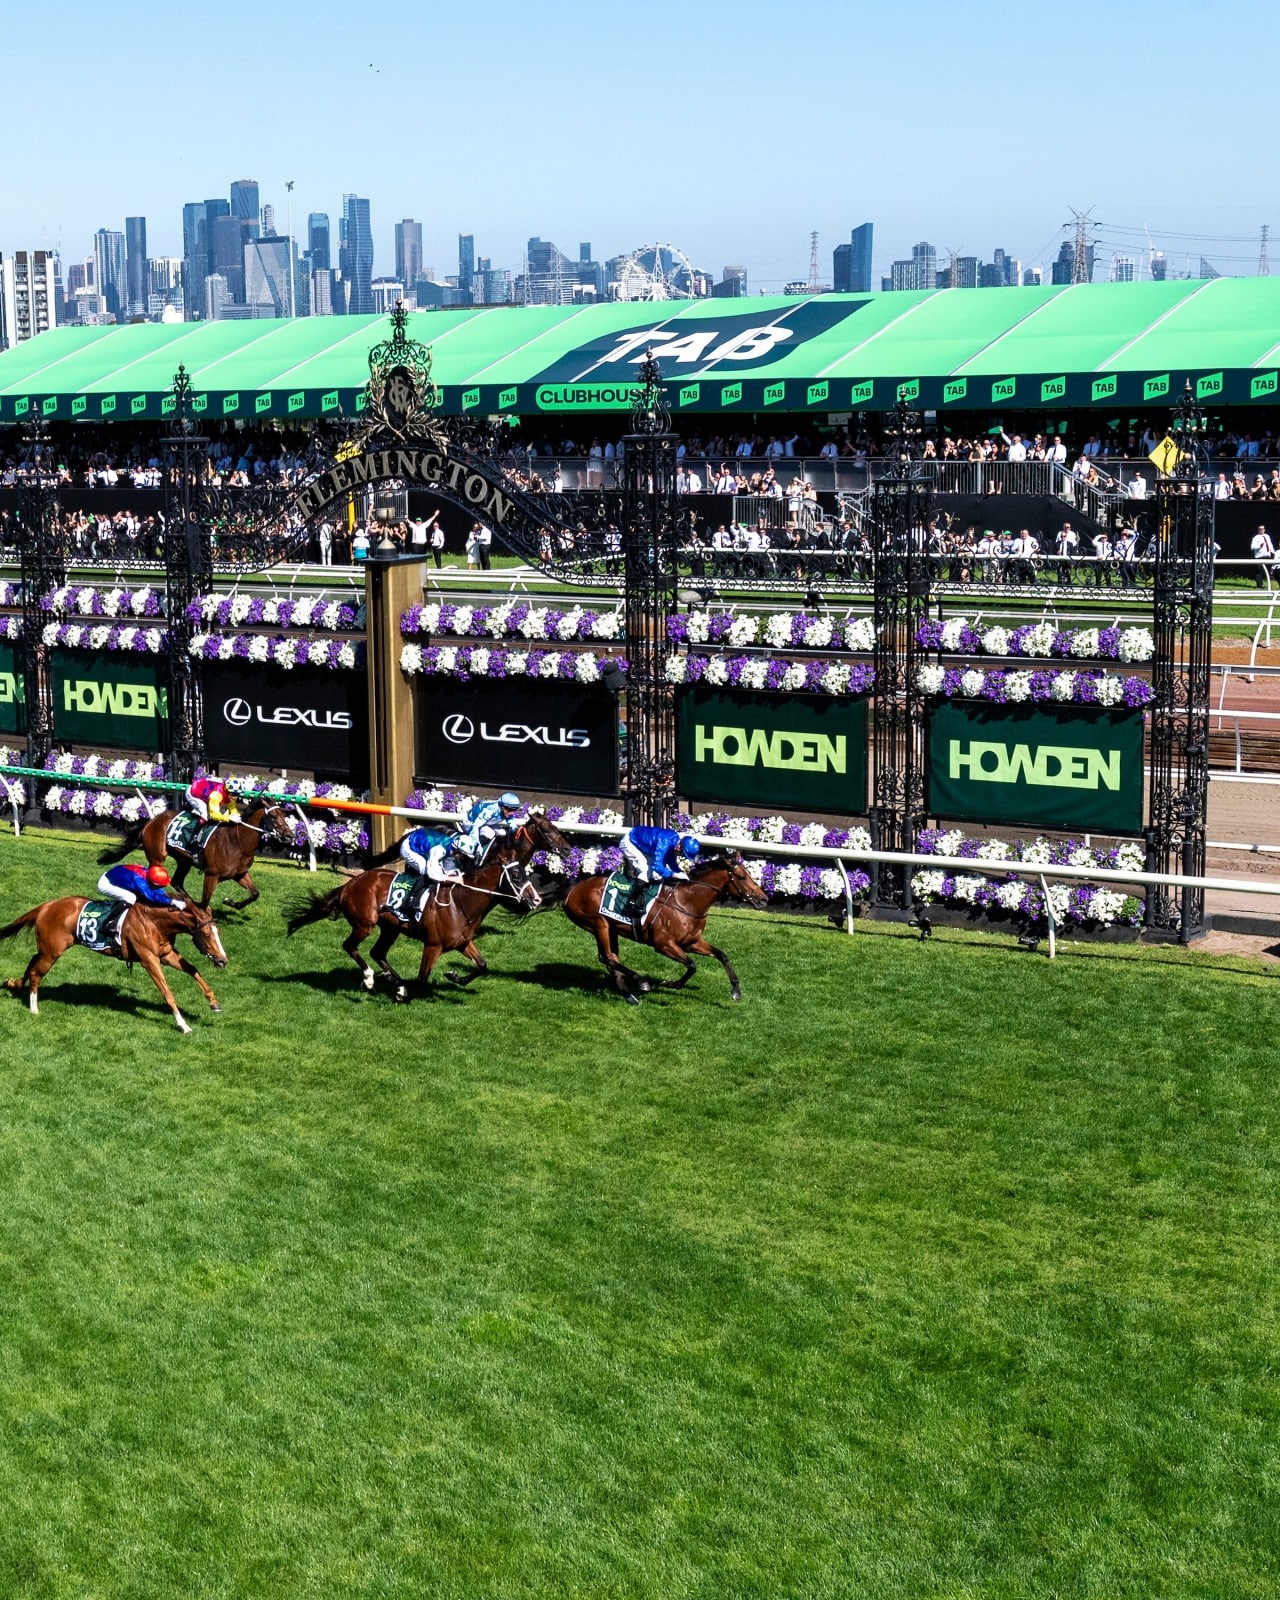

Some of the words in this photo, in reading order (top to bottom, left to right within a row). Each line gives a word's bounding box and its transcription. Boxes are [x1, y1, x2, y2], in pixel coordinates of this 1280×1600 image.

[596, 326, 794, 364] TAB
[1043, 384, 1064, 394] TAB
[1094, 382, 1115, 393] TAB
[1146, 382, 1167, 392] TAB
[1199, 380, 1221, 391] TAB
[1254, 379, 1275, 390] TAB
[681, 390, 698, 400] TAB
[723, 389, 740, 399] TAB
[766, 389, 783, 398] TAB
[809, 388, 827, 398] TAB
[854, 387, 872, 397] TAB
[946, 385, 965, 396] TAB
[994, 385, 1014, 395] TAB
[463, 394, 479, 403] TAB
[500, 393, 516, 403] TAB
[539, 388, 649, 404] CLUBHOUS
[16, 401, 28, 410] TAB
[44, 401, 56, 410] TAB
[73, 401, 85, 409] TAB
[102, 400, 115, 409] TAB
[132, 400, 145, 408] TAB
[224, 399, 238, 408] TAB
[257, 398, 270, 407] TAB
[289, 398, 304, 406] TAB
[323, 397, 337, 406] TAB
[296, 450, 515, 523] FLEMINGTON
[64, 679, 168, 718] HOWDEN
[256, 705, 352, 729] LEXUS
[480, 722, 591, 748] LEXUS
[695, 725, 847, 773] HOWDEN
[949, 739, 1121, 790] HOWDEN
[167, 820, 187, 841] 14
[608, 887, 618, 911] 1
[80, 917, 98, 942] 13
